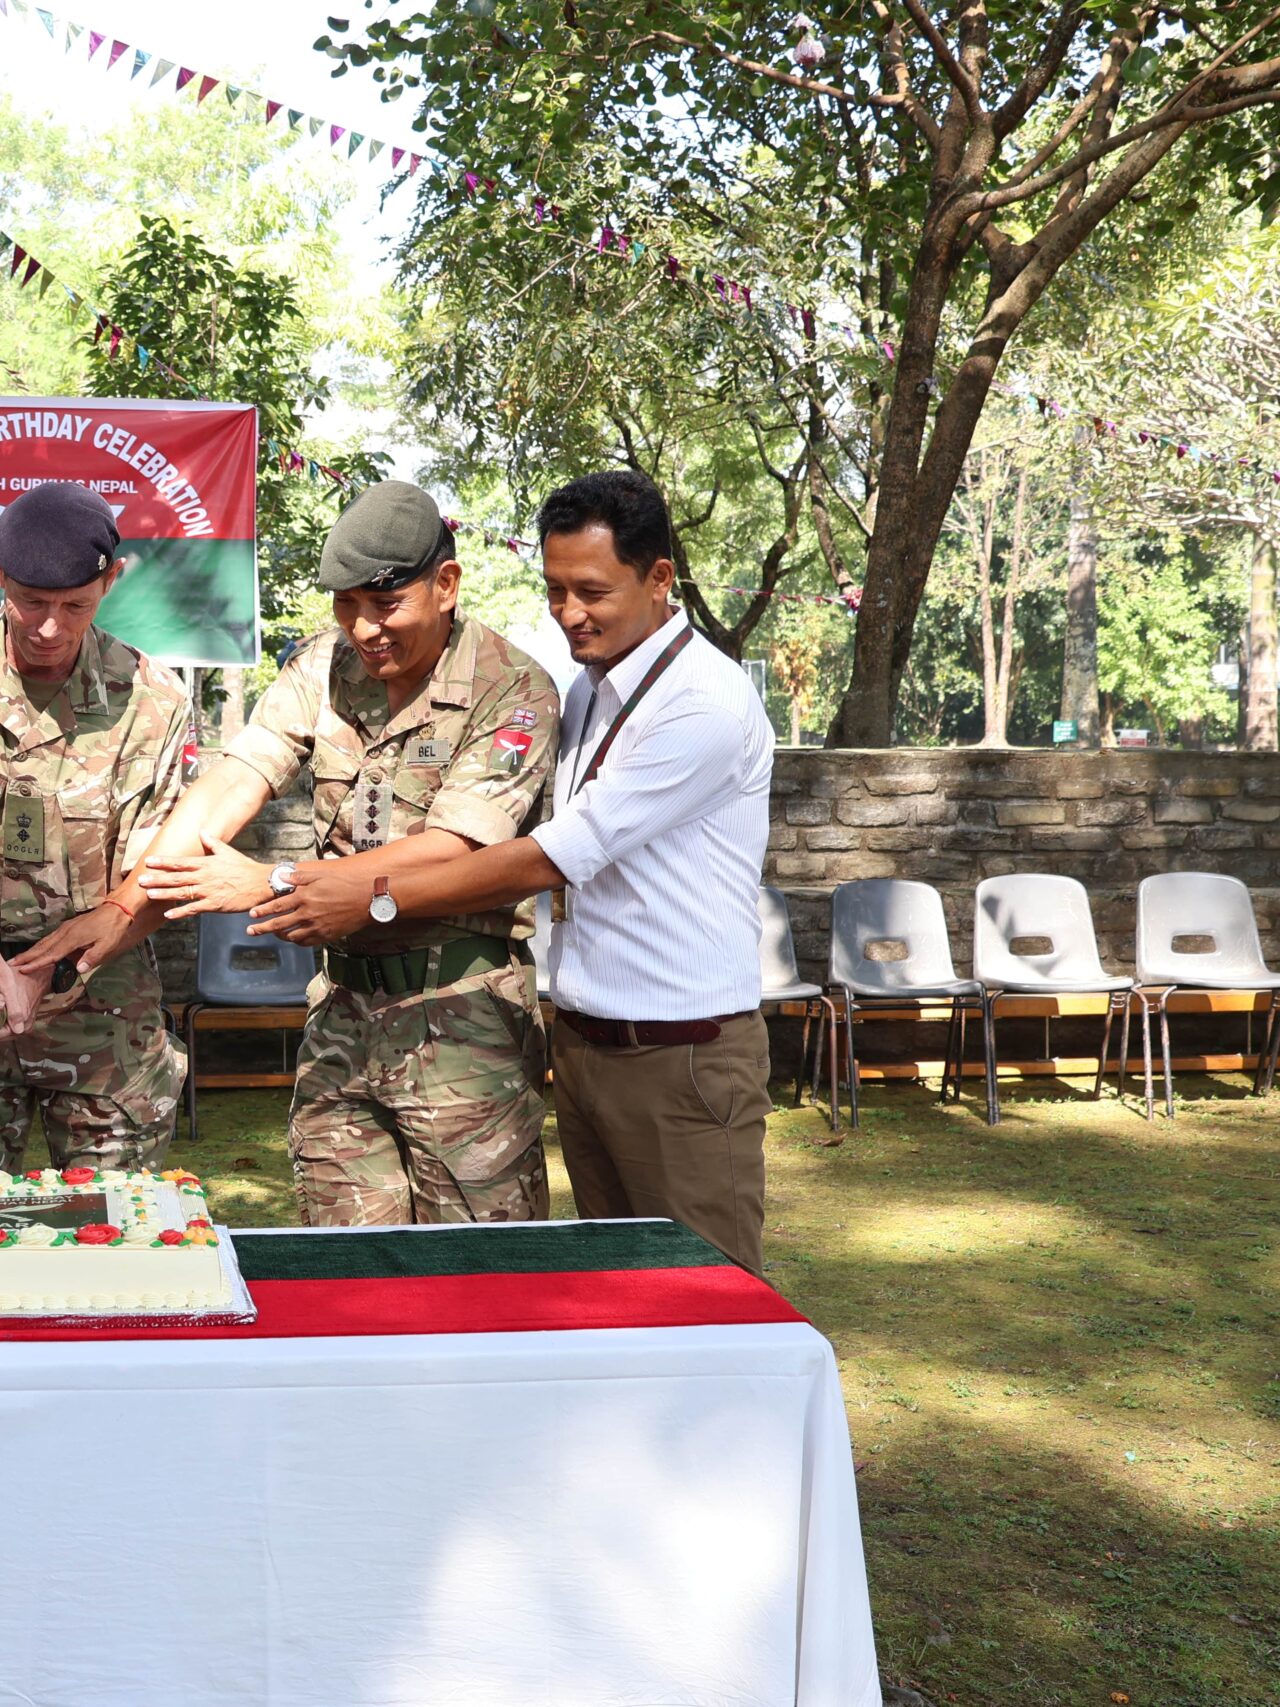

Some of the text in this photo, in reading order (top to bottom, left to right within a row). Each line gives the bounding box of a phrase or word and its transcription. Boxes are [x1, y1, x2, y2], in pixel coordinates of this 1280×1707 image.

[10, 477, 86, 491] GURS
[89, 480, 139, 494] NEPAL
[93, 423, 215, 537] CELEBRATION
[418, 745, 436, 757] BEL
